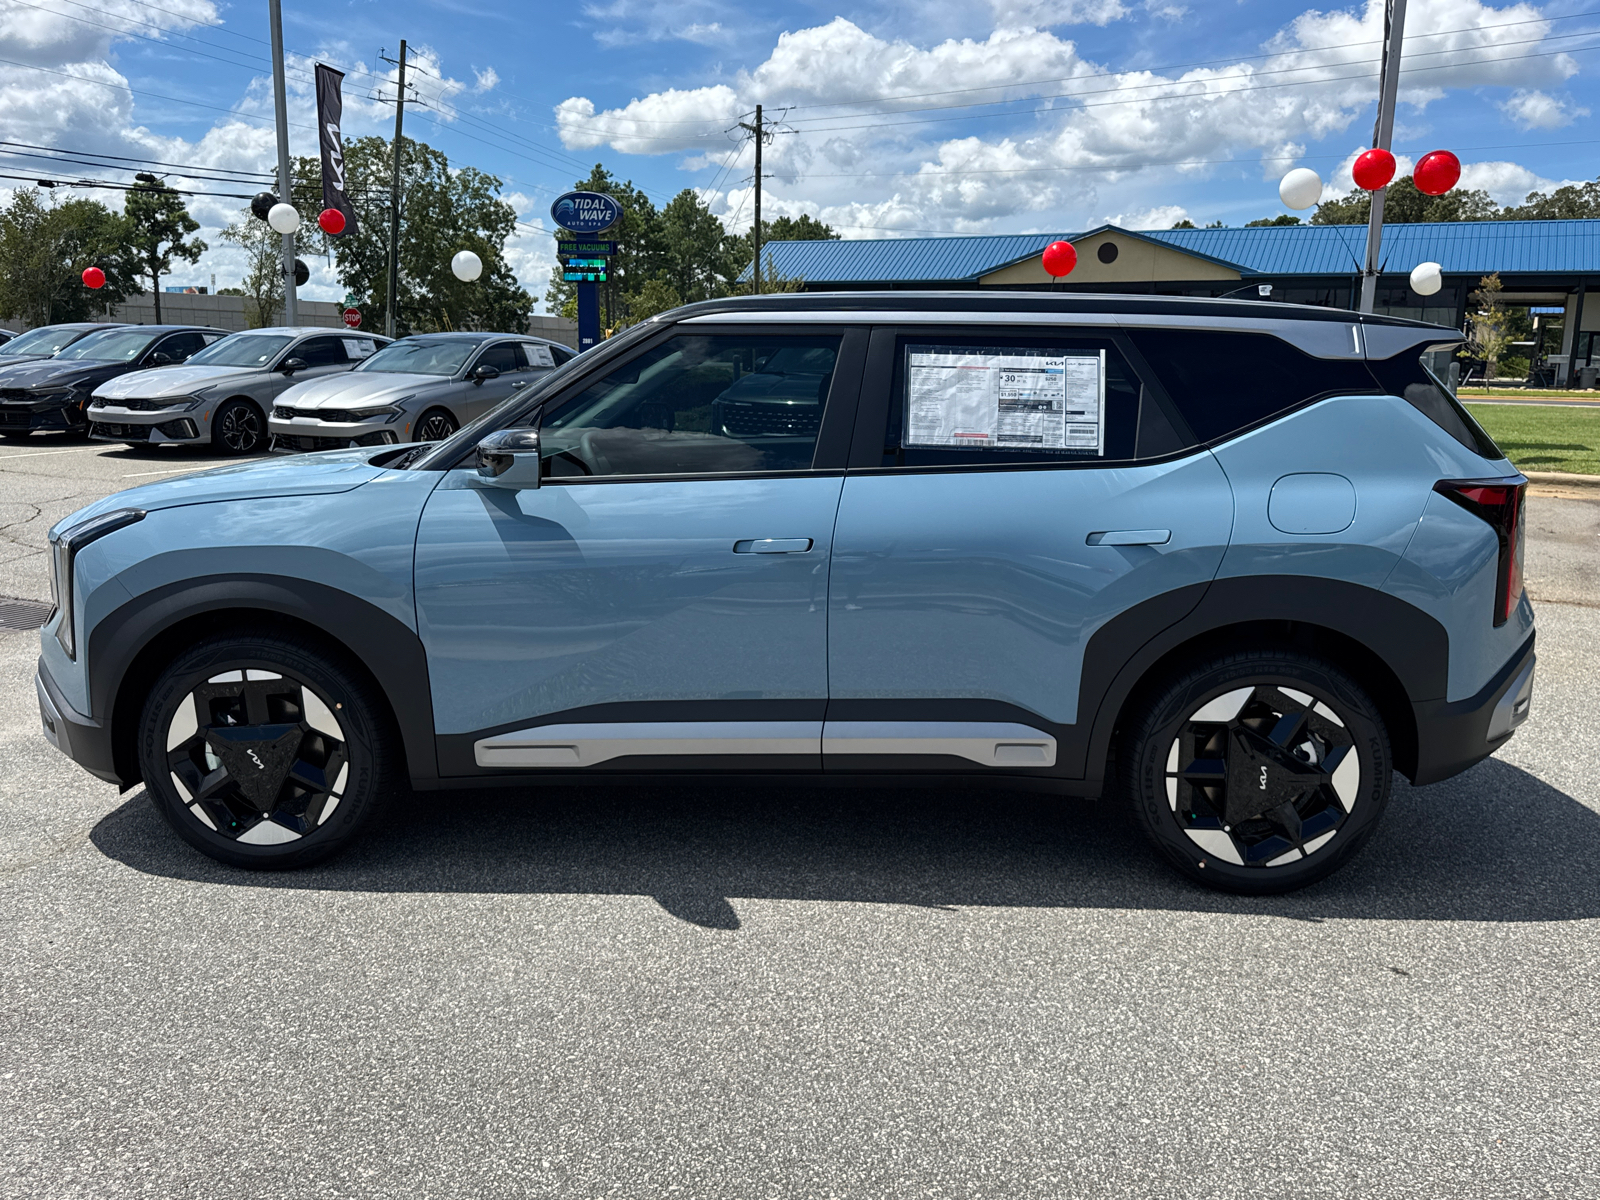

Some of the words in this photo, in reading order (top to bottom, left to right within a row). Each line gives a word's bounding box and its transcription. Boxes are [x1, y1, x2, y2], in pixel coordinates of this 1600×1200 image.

[574, 198, 606, 210] TIDAL
[579, 209, 612, 221] WAVE
[560, 243, 577, 251] FREE
[578, 243, 610, 251] VACUUMS
[344, 313, 360, 322] STOP
[1004, 374, 1016, 382] 30
[145, 700, 163, 760] SOLUS
[1368, 735, 1383, 802] KUMHO
[343, 766, 369, 824] KUMHO
[1145, 764, 1163, 826] SOLUS
